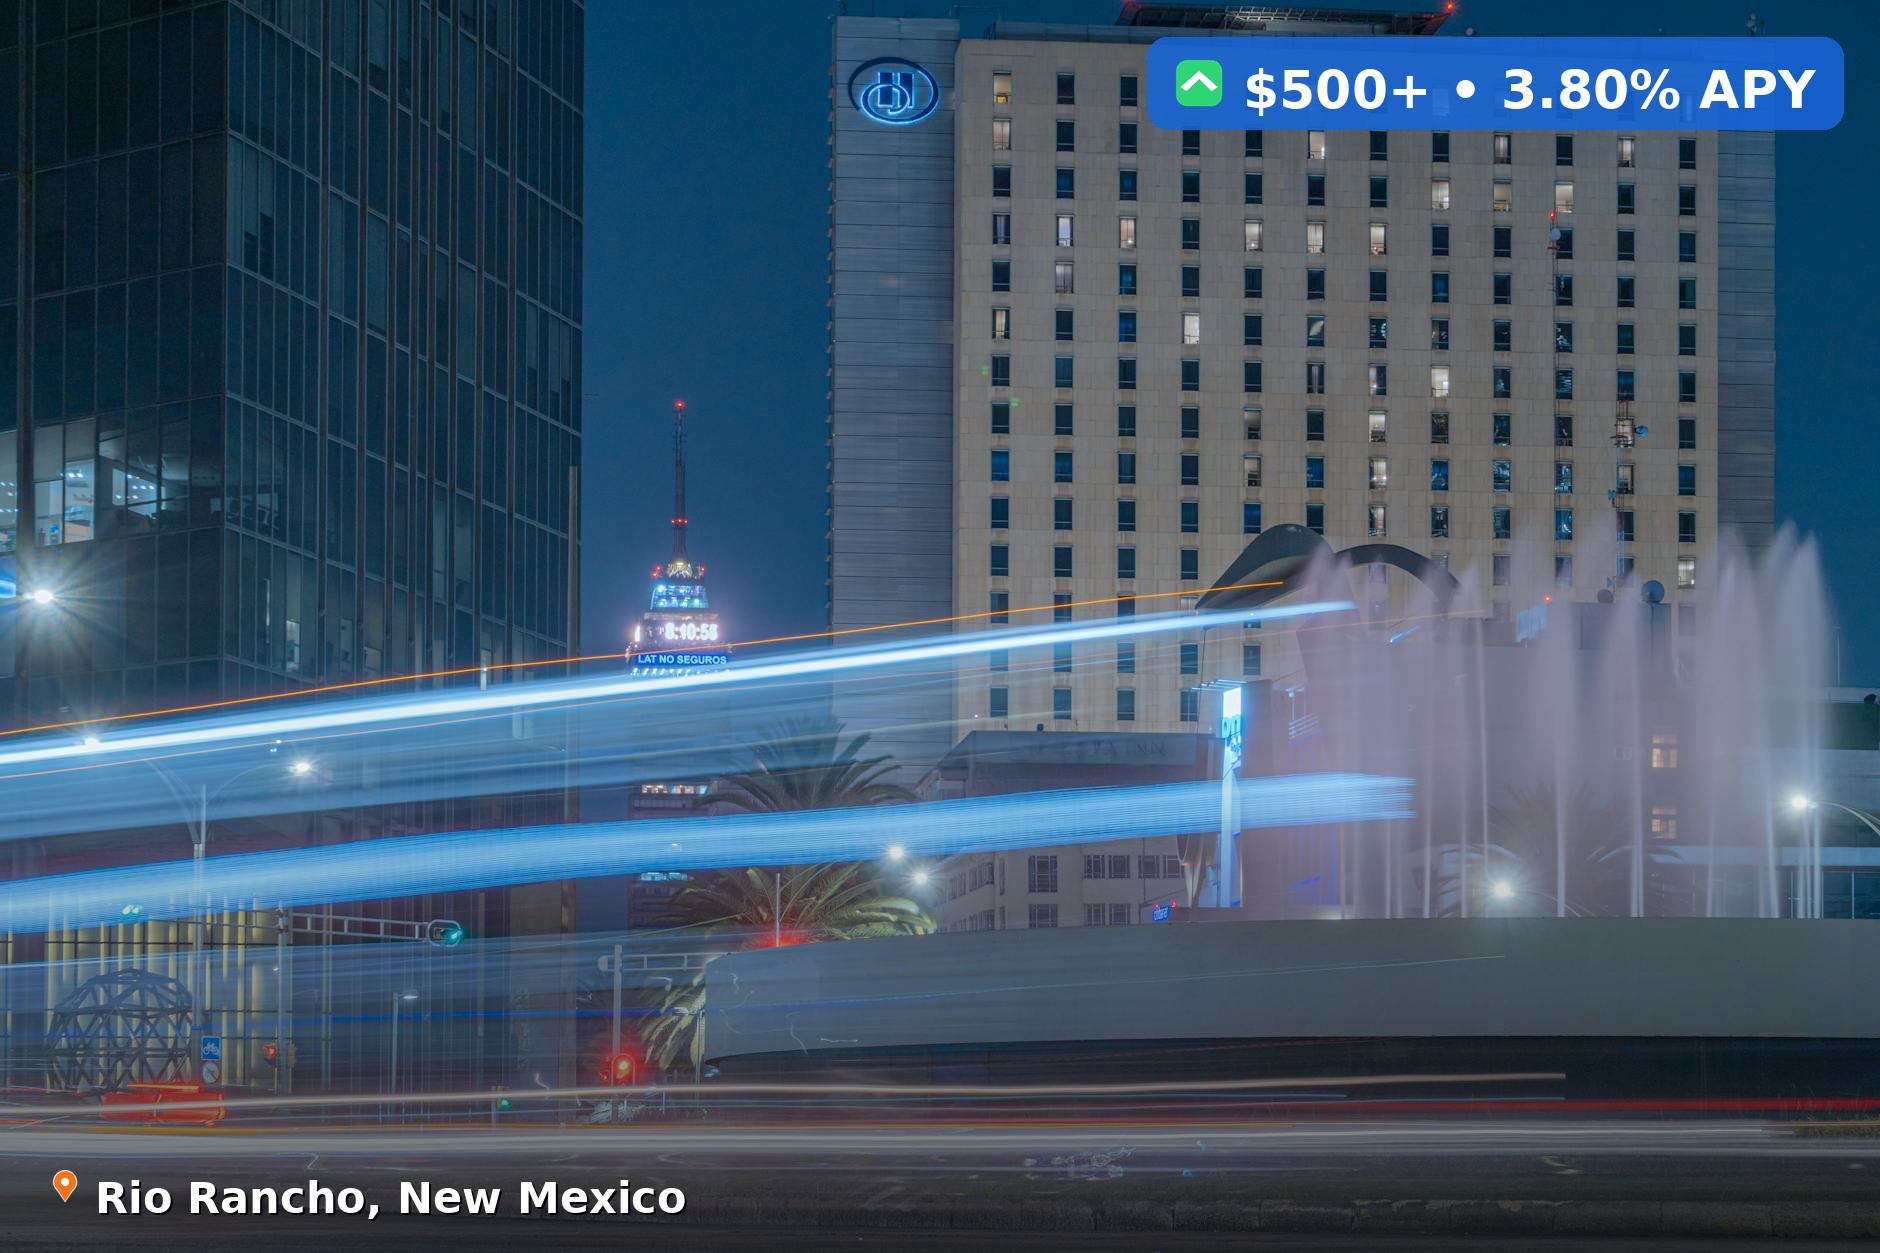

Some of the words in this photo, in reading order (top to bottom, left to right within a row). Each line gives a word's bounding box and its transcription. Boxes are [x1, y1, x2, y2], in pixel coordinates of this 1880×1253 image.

[638, 654, 657, 664] LAT
[659, 655, 675, 664] NO
[677, 655, 727, 665] SEGUROS
